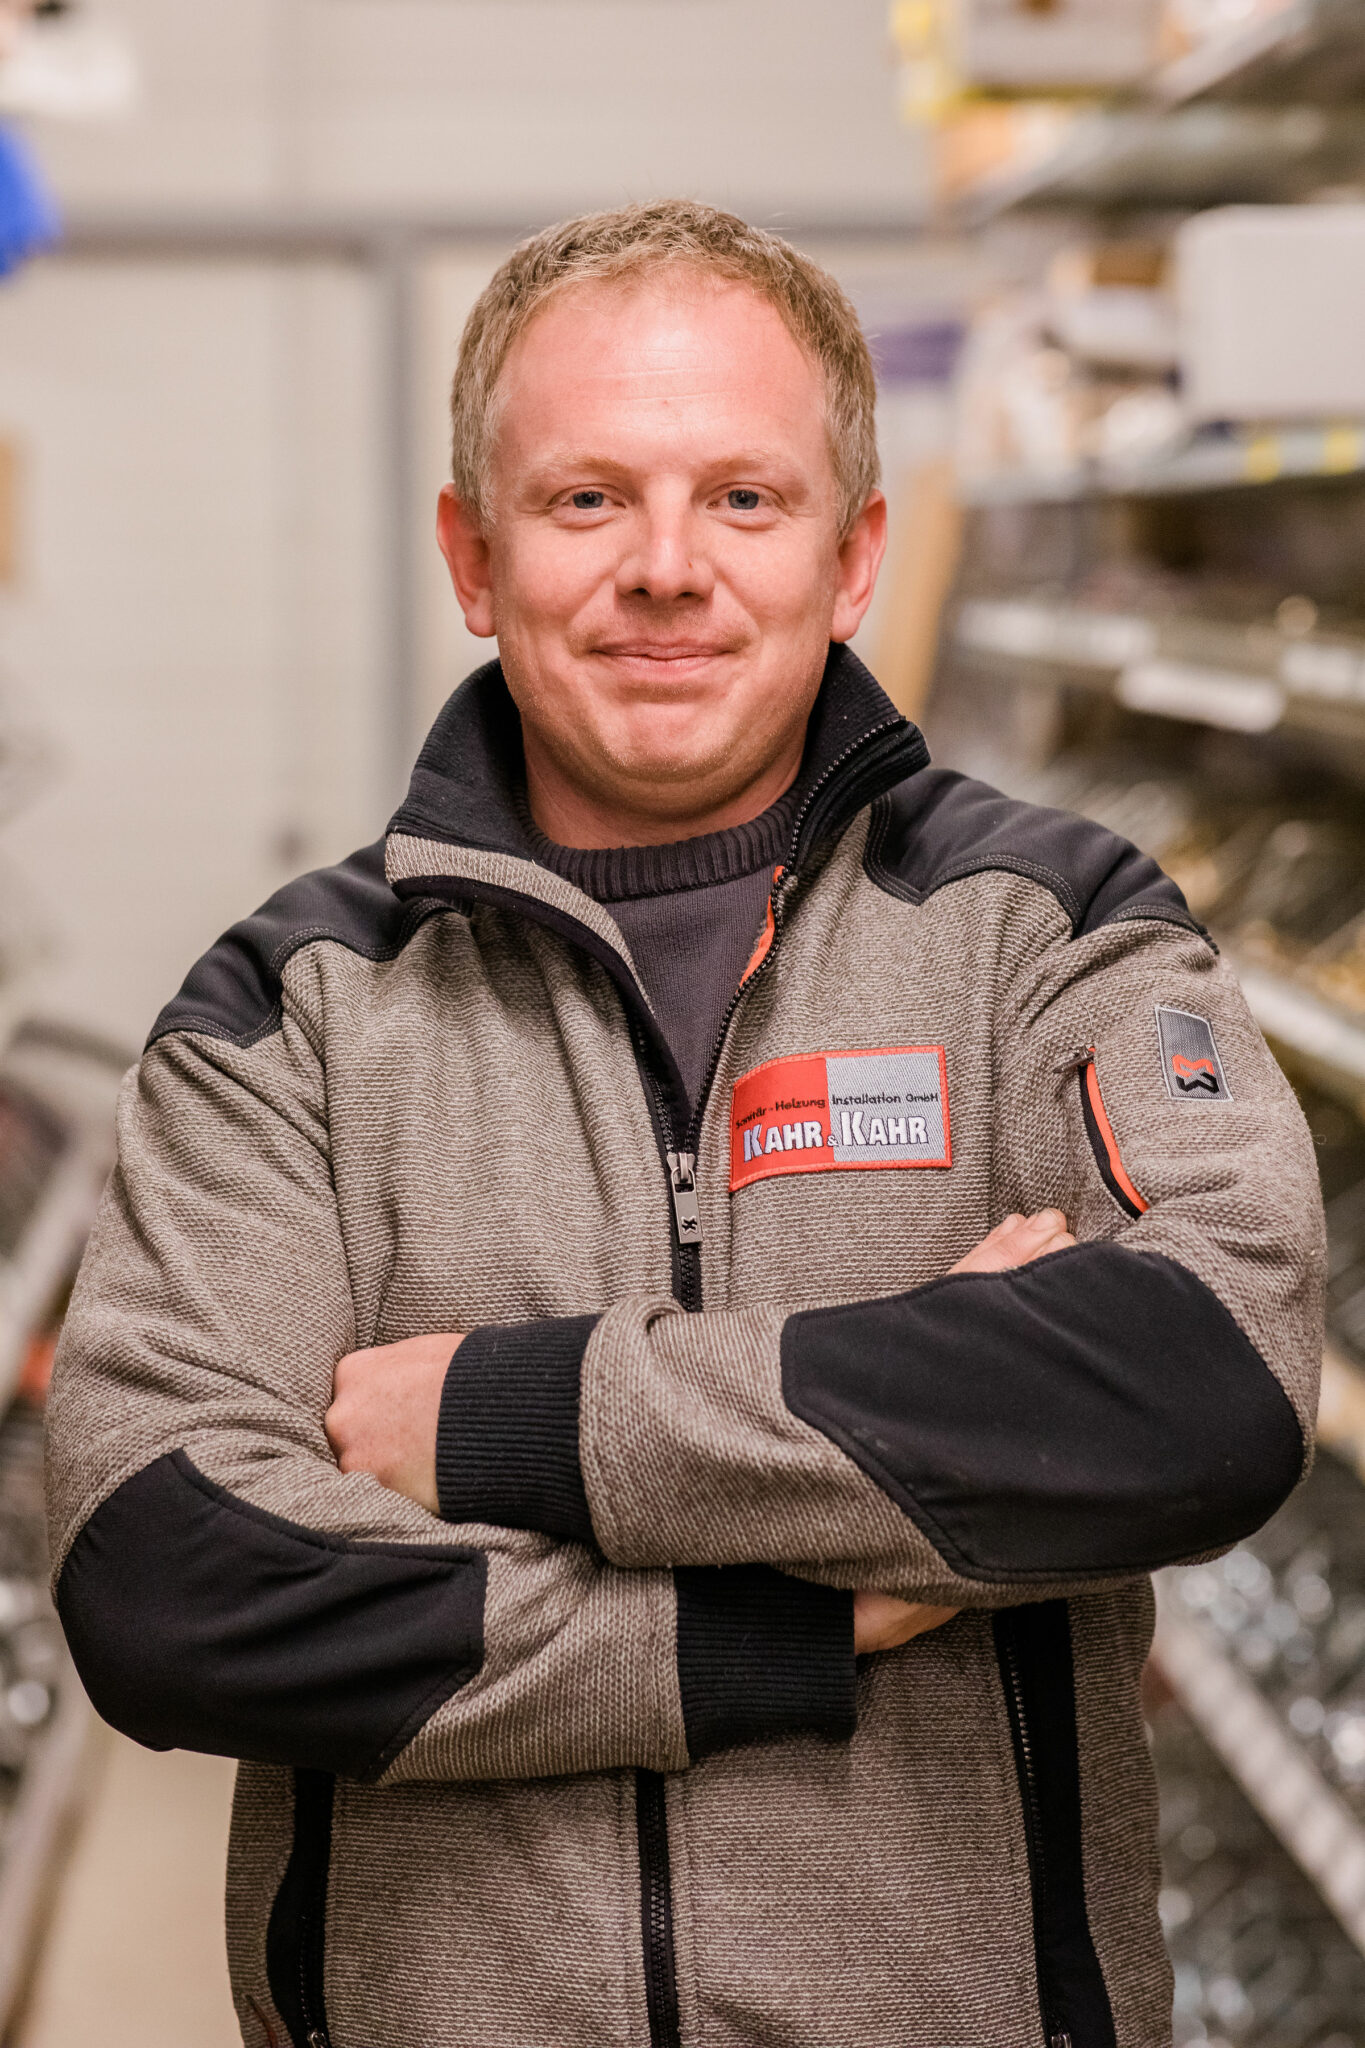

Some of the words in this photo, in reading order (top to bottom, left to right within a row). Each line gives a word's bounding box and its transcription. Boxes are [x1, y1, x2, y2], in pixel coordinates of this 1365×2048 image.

[775, 1097, 826, 1109] Heizung
[832, 1092, 901, 1106] Installation
[905, 1092, 938, 1103] GmbH
[743, 1120, 823, 1163] KAHR
[826, 1134, 840, 1148] &
[840, 1111, 929, 1147] KAHR
